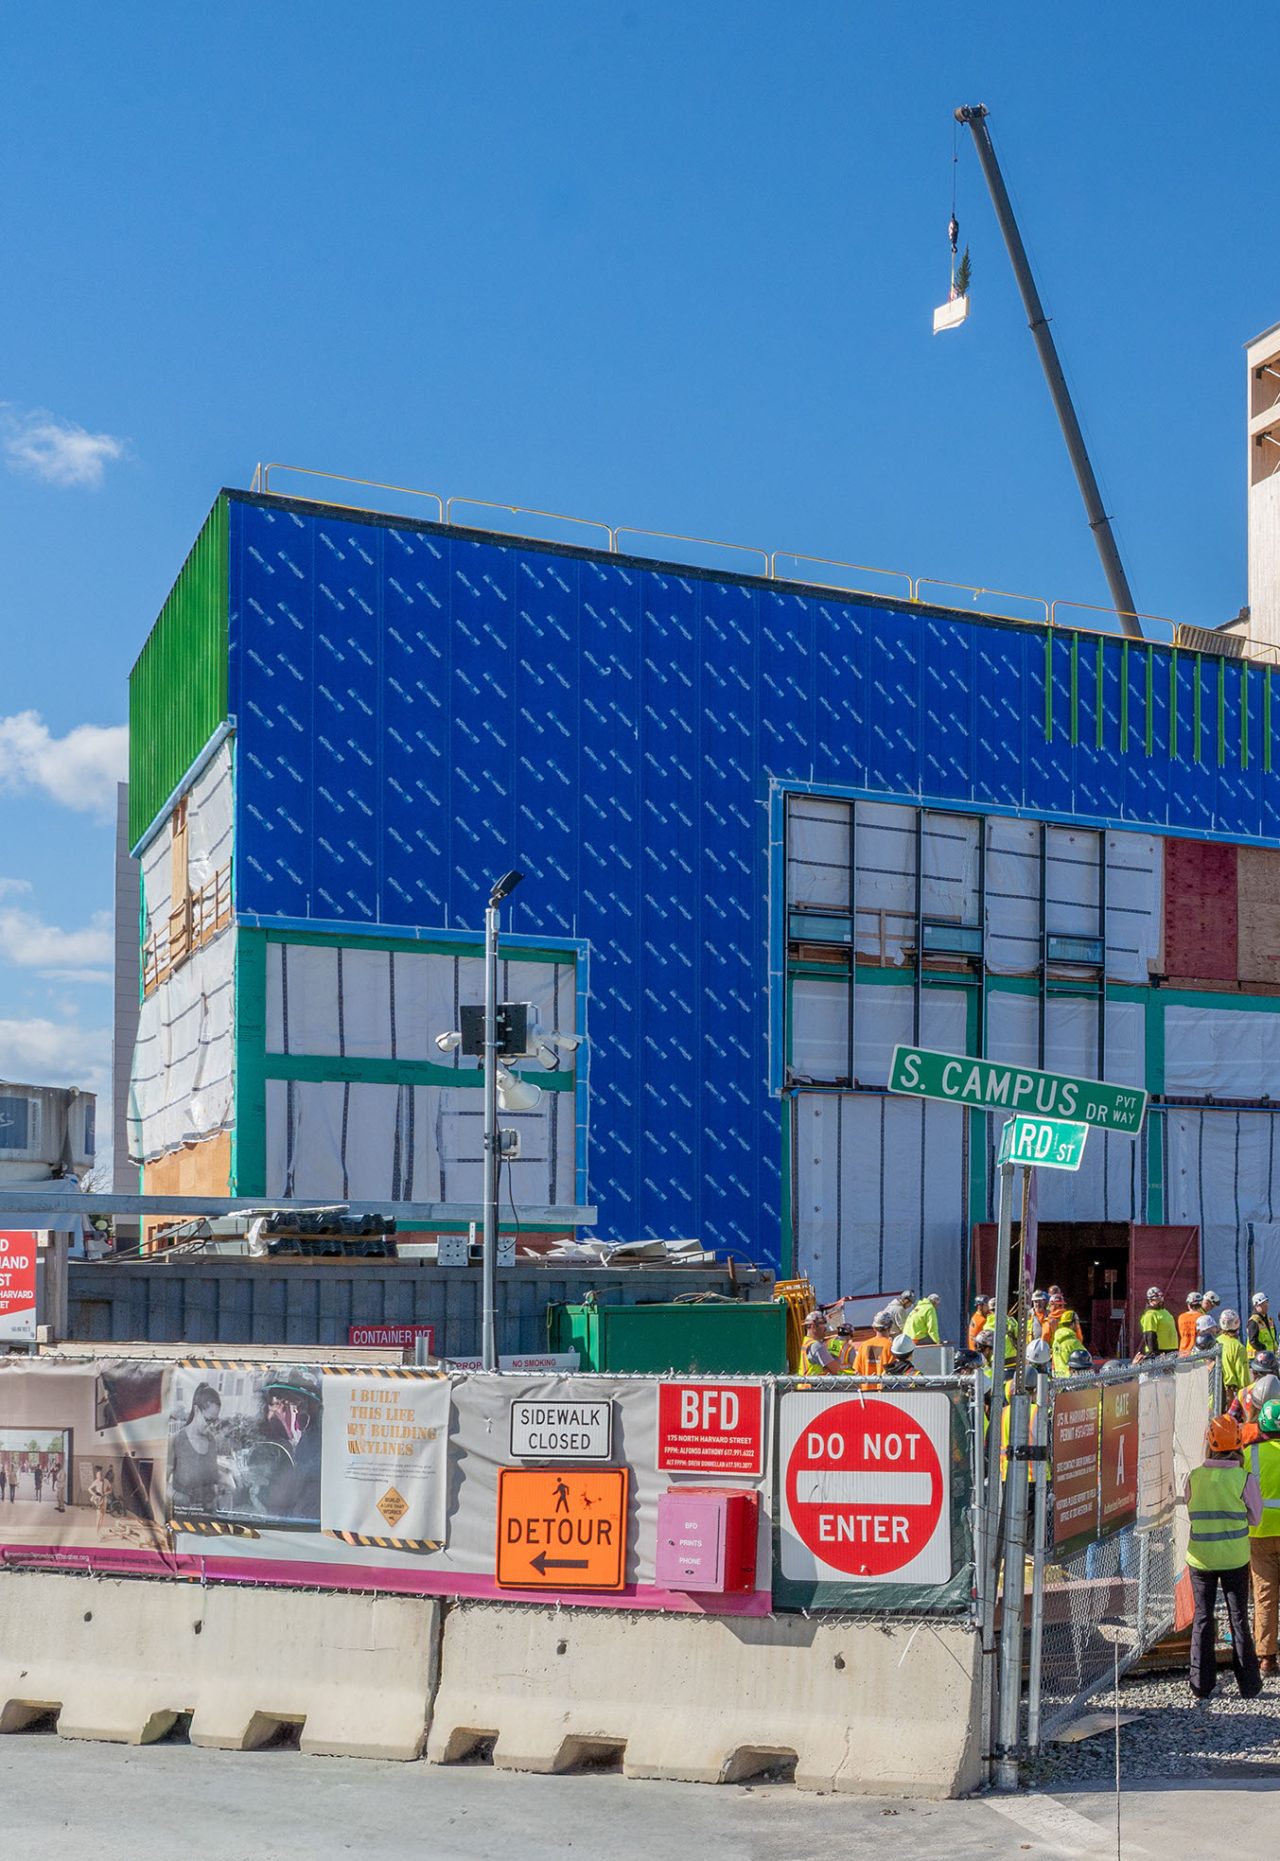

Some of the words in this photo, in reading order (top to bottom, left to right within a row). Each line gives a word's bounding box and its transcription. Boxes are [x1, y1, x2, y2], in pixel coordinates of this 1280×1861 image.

[900, 1054, 926, 1090] S.
[942, 1061, 1079, 1116] CAMPUS
[1086, 1103, 1108, 1122] DR
[1116, 1095, 1137, 1110] PVT
[1113, 1109, 1136, 1124] WAY
[1056, 1144, 1075, 1163] ST
[353, 1329, 412, 1345] CONTAINER
[512, 1360, 523, 1368] NO
[524, 1359, 557, 1367] SMOKING
[351, 1389, 356, 1402] I
[360, 1390, 400, 1404] BUILT
[681, 1389, 739, 1431] BFD
[1115, 1392, 1130, 1418] GATE
[350, 1406, 382, 1420] THIS
[385, 1407, 416, 1422] LIFE
[520, 1408, 601, 1426] SIDEWALK
[371, 1424, 438, 1440] BUILDING
[678, 1435, 699, 1443] NORTH
[700, 1436, 729, 1444] HARVARD
[729, 1437, 752, 1445] STREET
[528, 1433, 591, 1450] CLOSED
[807, 1432, 845, 1460] DO
[863, 1433, 921, 1461] NOT
[1116, 1434, 1125, 1487] A
[507, 1518, 612, 1546] DETOUR
[684, 1522, 698, 1530] BFD
[818, 1514, 910, 1544] ENTER
[679, 1539, 703, 1548] PRINTS
[679, 1557, 702, 1565] PHONE
